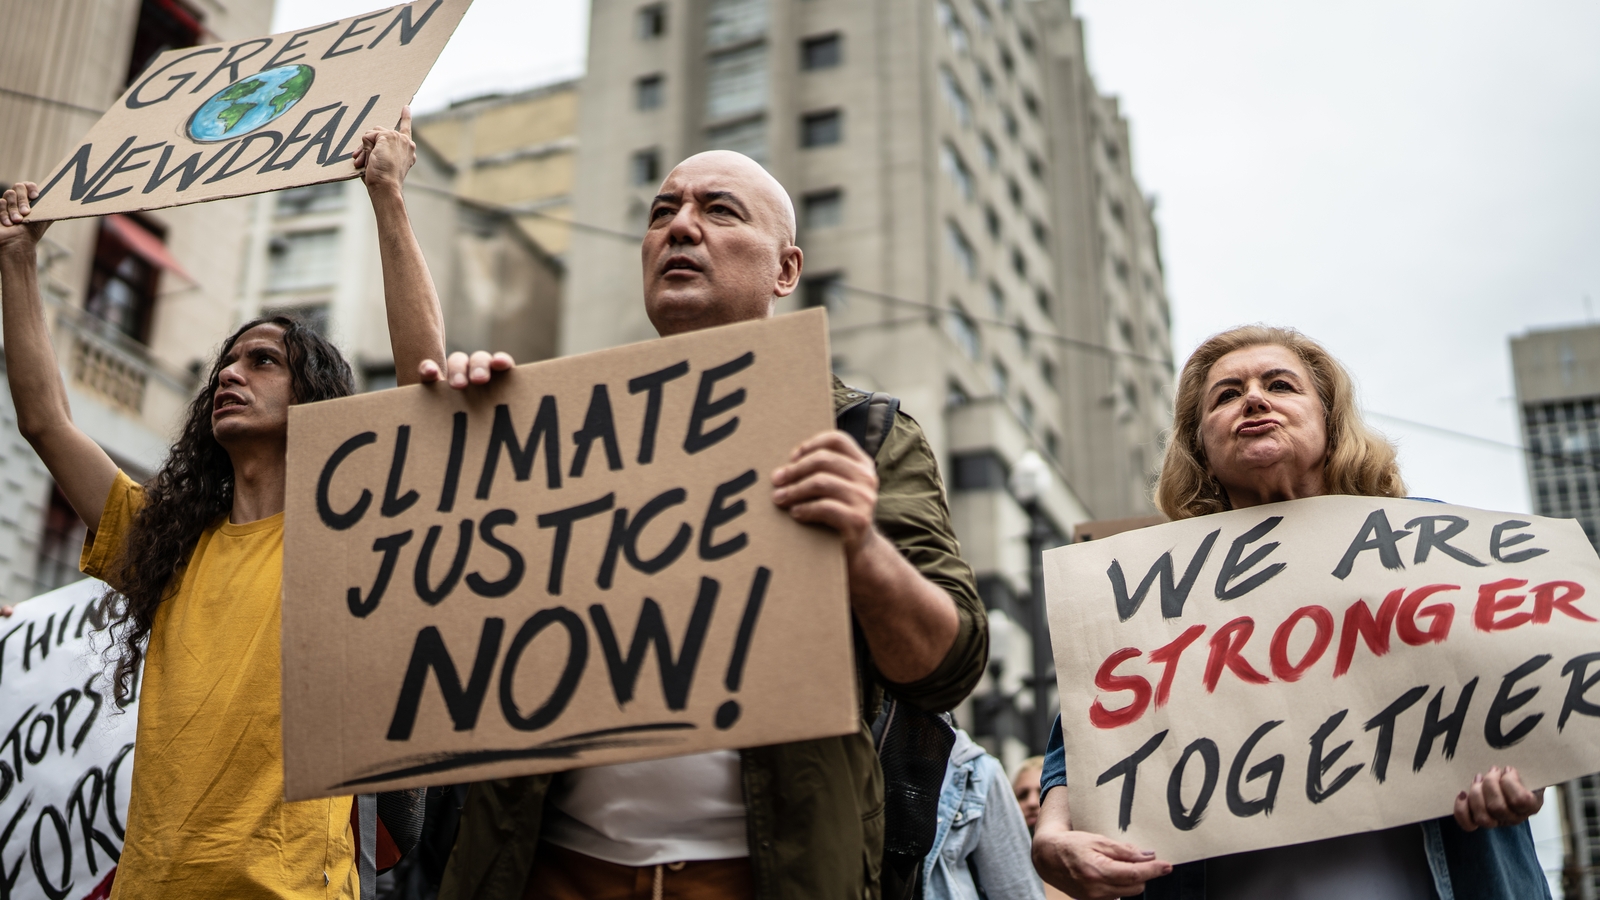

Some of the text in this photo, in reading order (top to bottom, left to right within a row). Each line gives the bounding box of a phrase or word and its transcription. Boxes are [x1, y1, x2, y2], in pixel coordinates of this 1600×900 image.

[126, 0, 444, 109] GREEN
[316, 351, 755, 531] CLIMATE
[347, 469, 758, 619] JUSTICE
[1107, 508, 1550, 623] WE ARE
[385, 566, 771, 742] NOW!
[1089, 578, 1598, 730] STRONGER
[1096, 652, 1600, 832] TOGETHER
